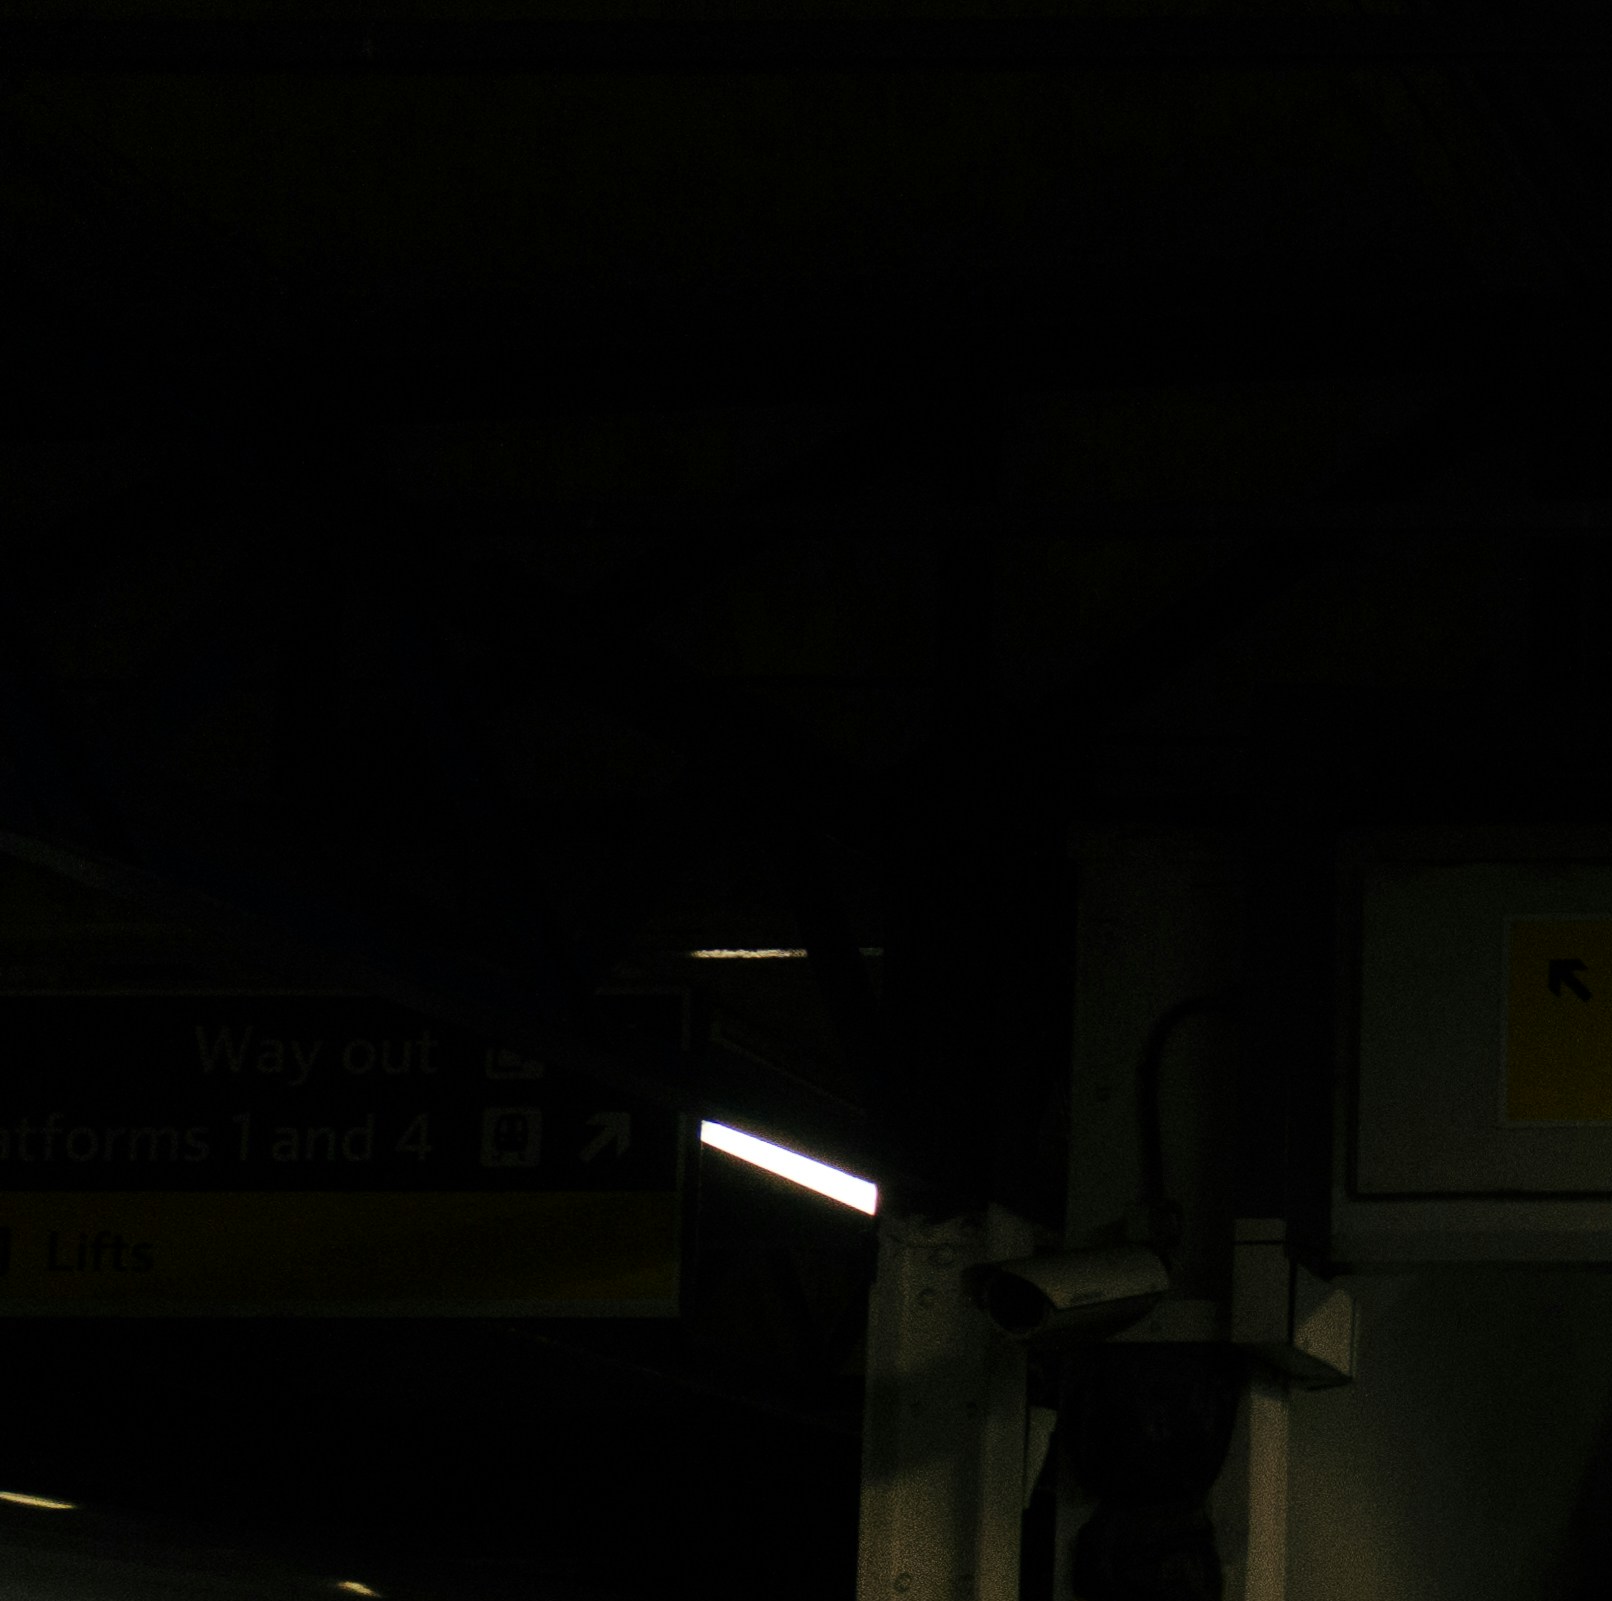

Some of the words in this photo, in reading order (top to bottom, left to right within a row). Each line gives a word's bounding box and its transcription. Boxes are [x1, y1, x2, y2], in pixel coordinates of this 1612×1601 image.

[193, 1022, 325, 1088] Way
[340, 1030, 438, 1076] out
[232, 1111, 253, 1162] 1
[270, 1110, 376, 1163] and
[398, 1111, 434, 1161] 4
[47, 1230, 154, 1274] Lifts
